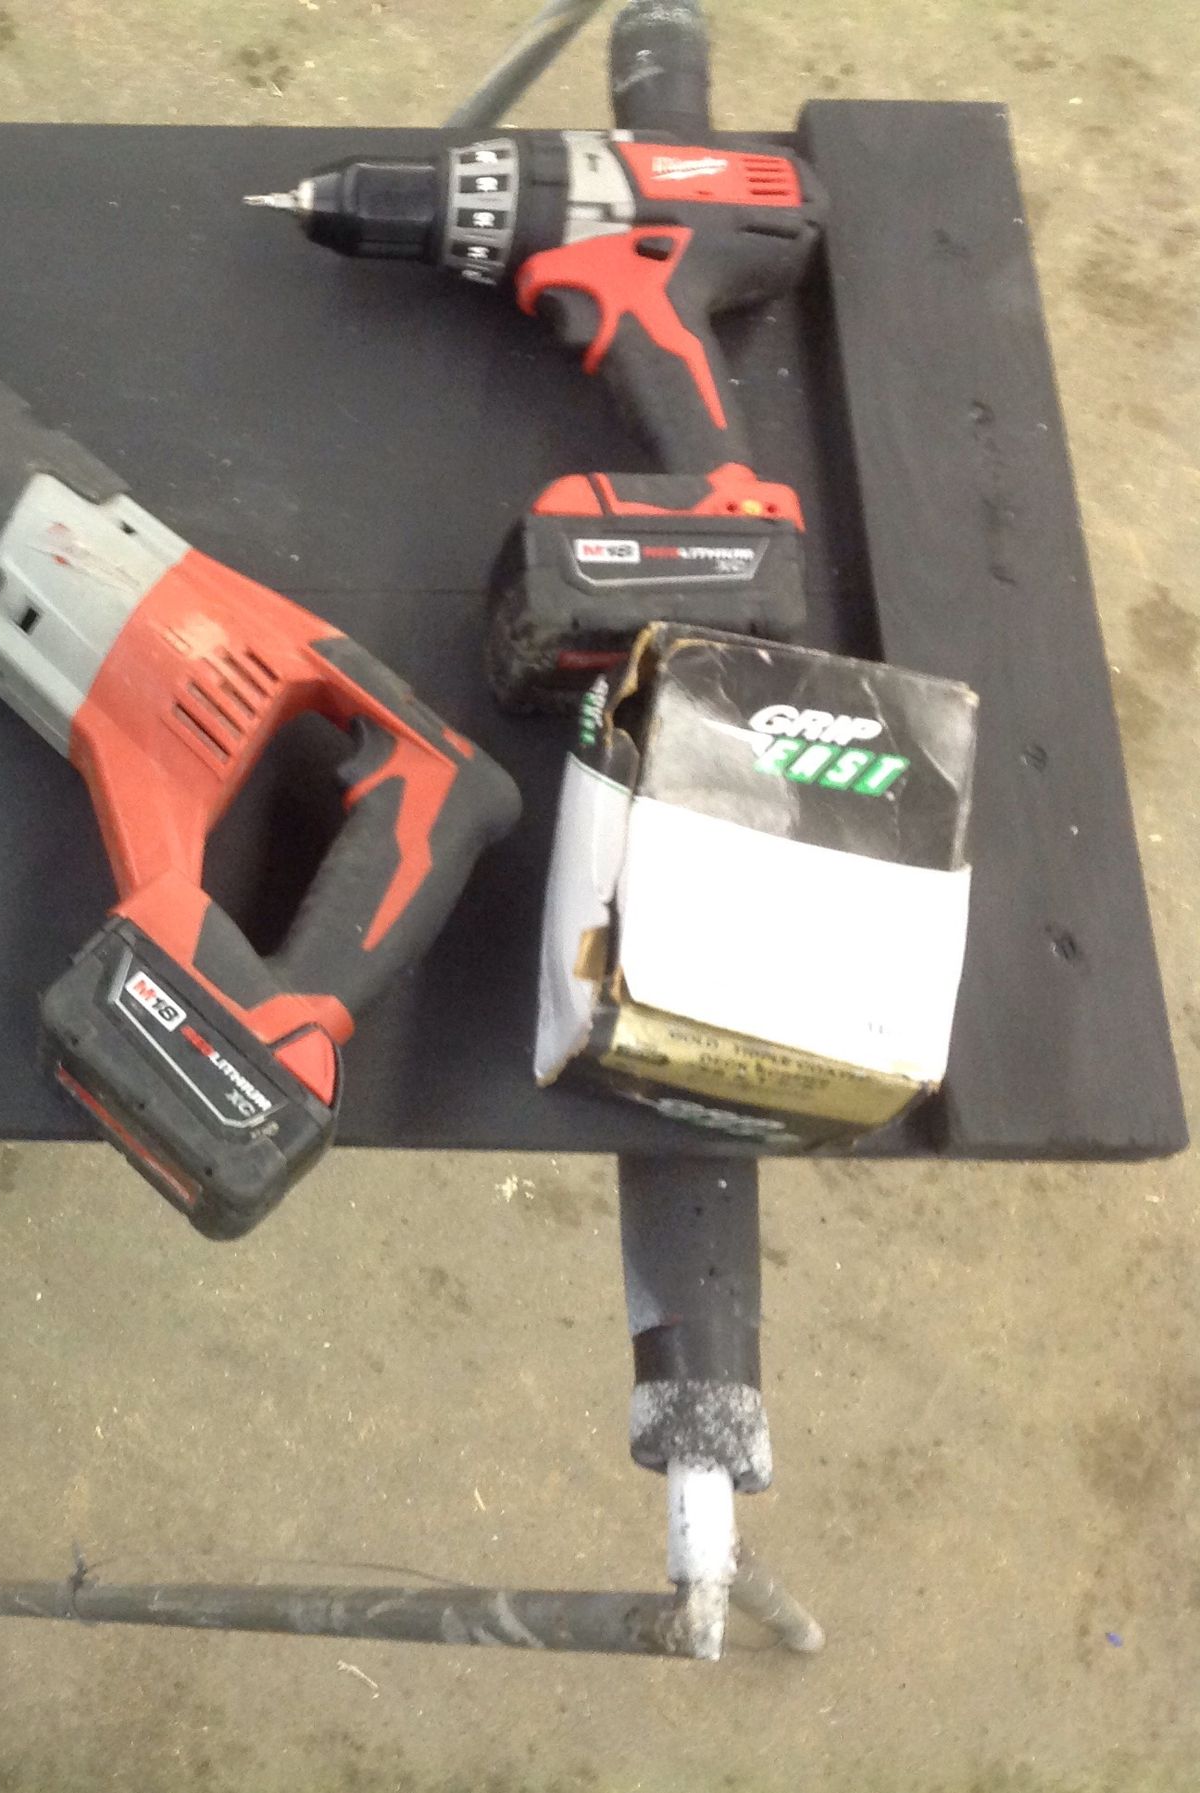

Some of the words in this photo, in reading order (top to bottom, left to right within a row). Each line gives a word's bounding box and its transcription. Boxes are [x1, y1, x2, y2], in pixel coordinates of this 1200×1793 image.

[749, 704, 883, 746] GRIP
[756, 736, 910, 796] FAST
[132, 978, 181, 1023] M18
